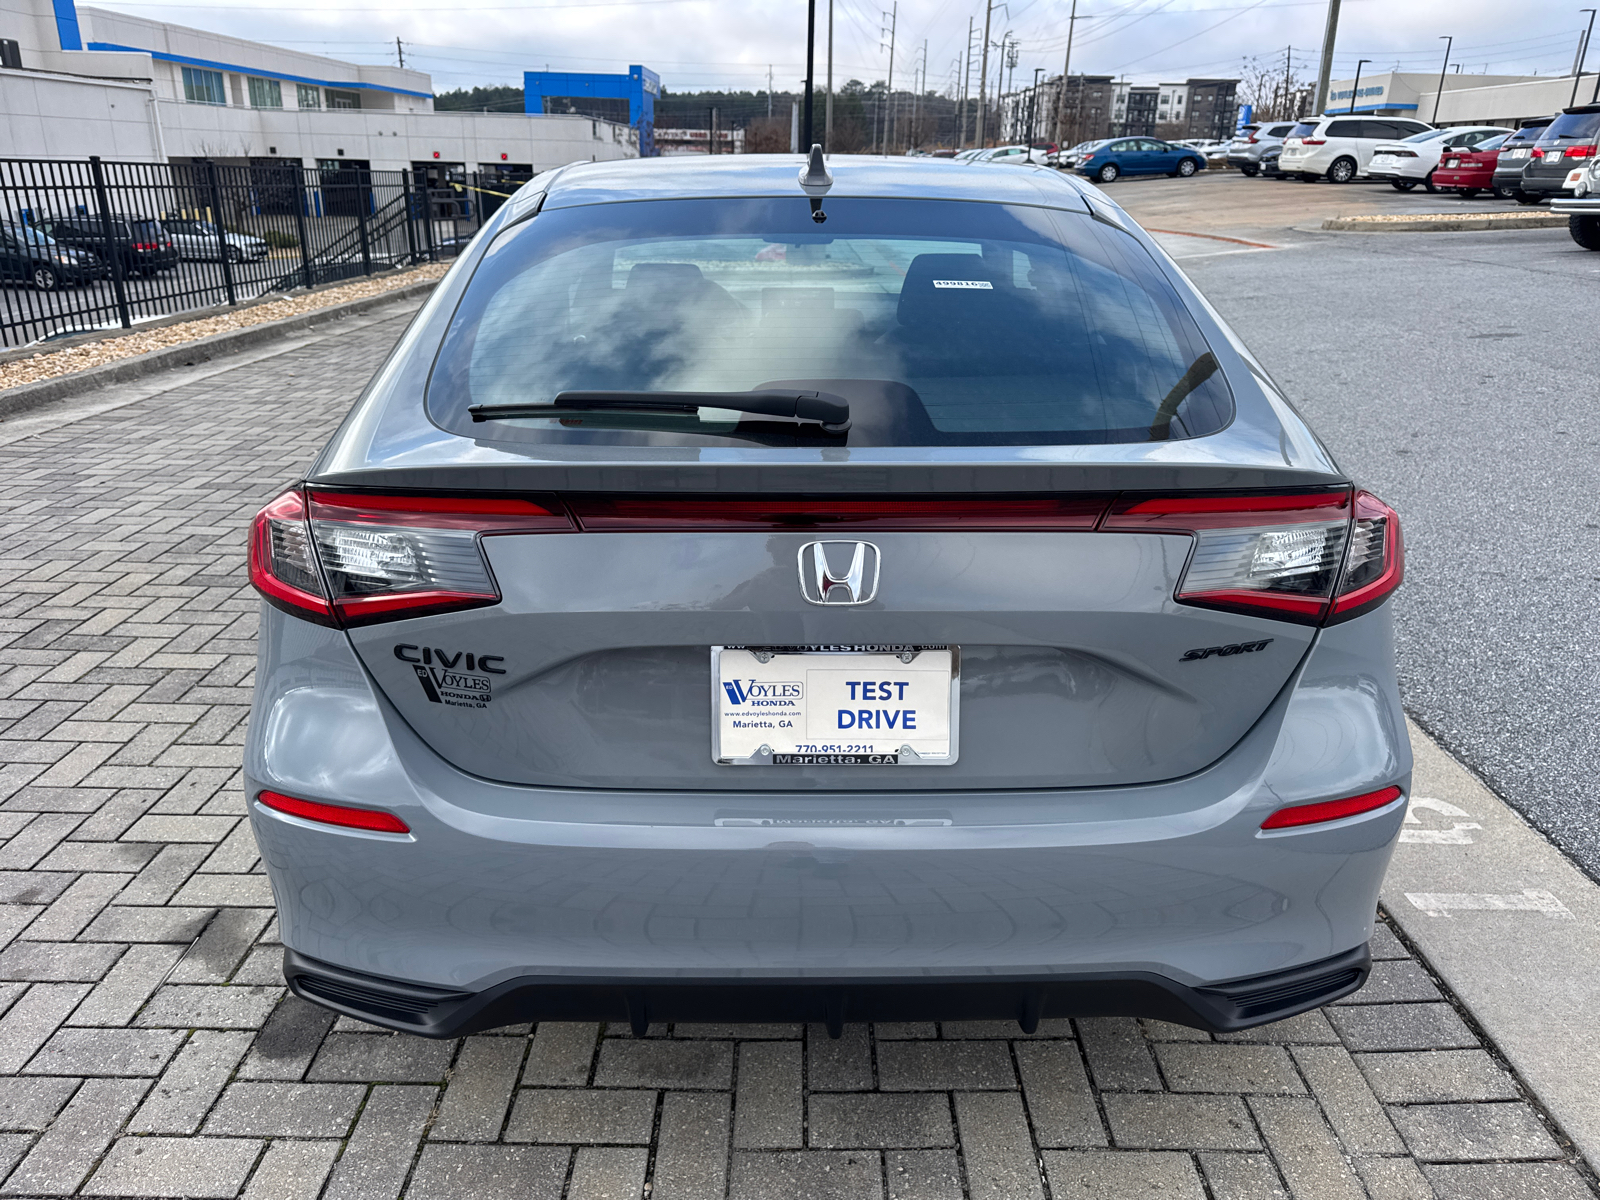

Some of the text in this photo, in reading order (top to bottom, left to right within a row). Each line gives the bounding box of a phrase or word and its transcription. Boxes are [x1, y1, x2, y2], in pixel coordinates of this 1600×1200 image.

[394, 643, 507, 674] CIVIC
[1179, 638, 1275, 662] SPORT
[428, 666, 491, 691] VOYLES
[732, 679, 801, 703] VOYLES
[845, 681, 910, 701] TEST
[724, 710, 802, 718] www.edvoyleshonda.com
[837, 709, 917, 730] DRIVE
[732, 720, 794, 729] Marietta, GA
[795, 744, 874, 753] 770-951-2211
[776, 754, 896, 764] Marietta, GA
